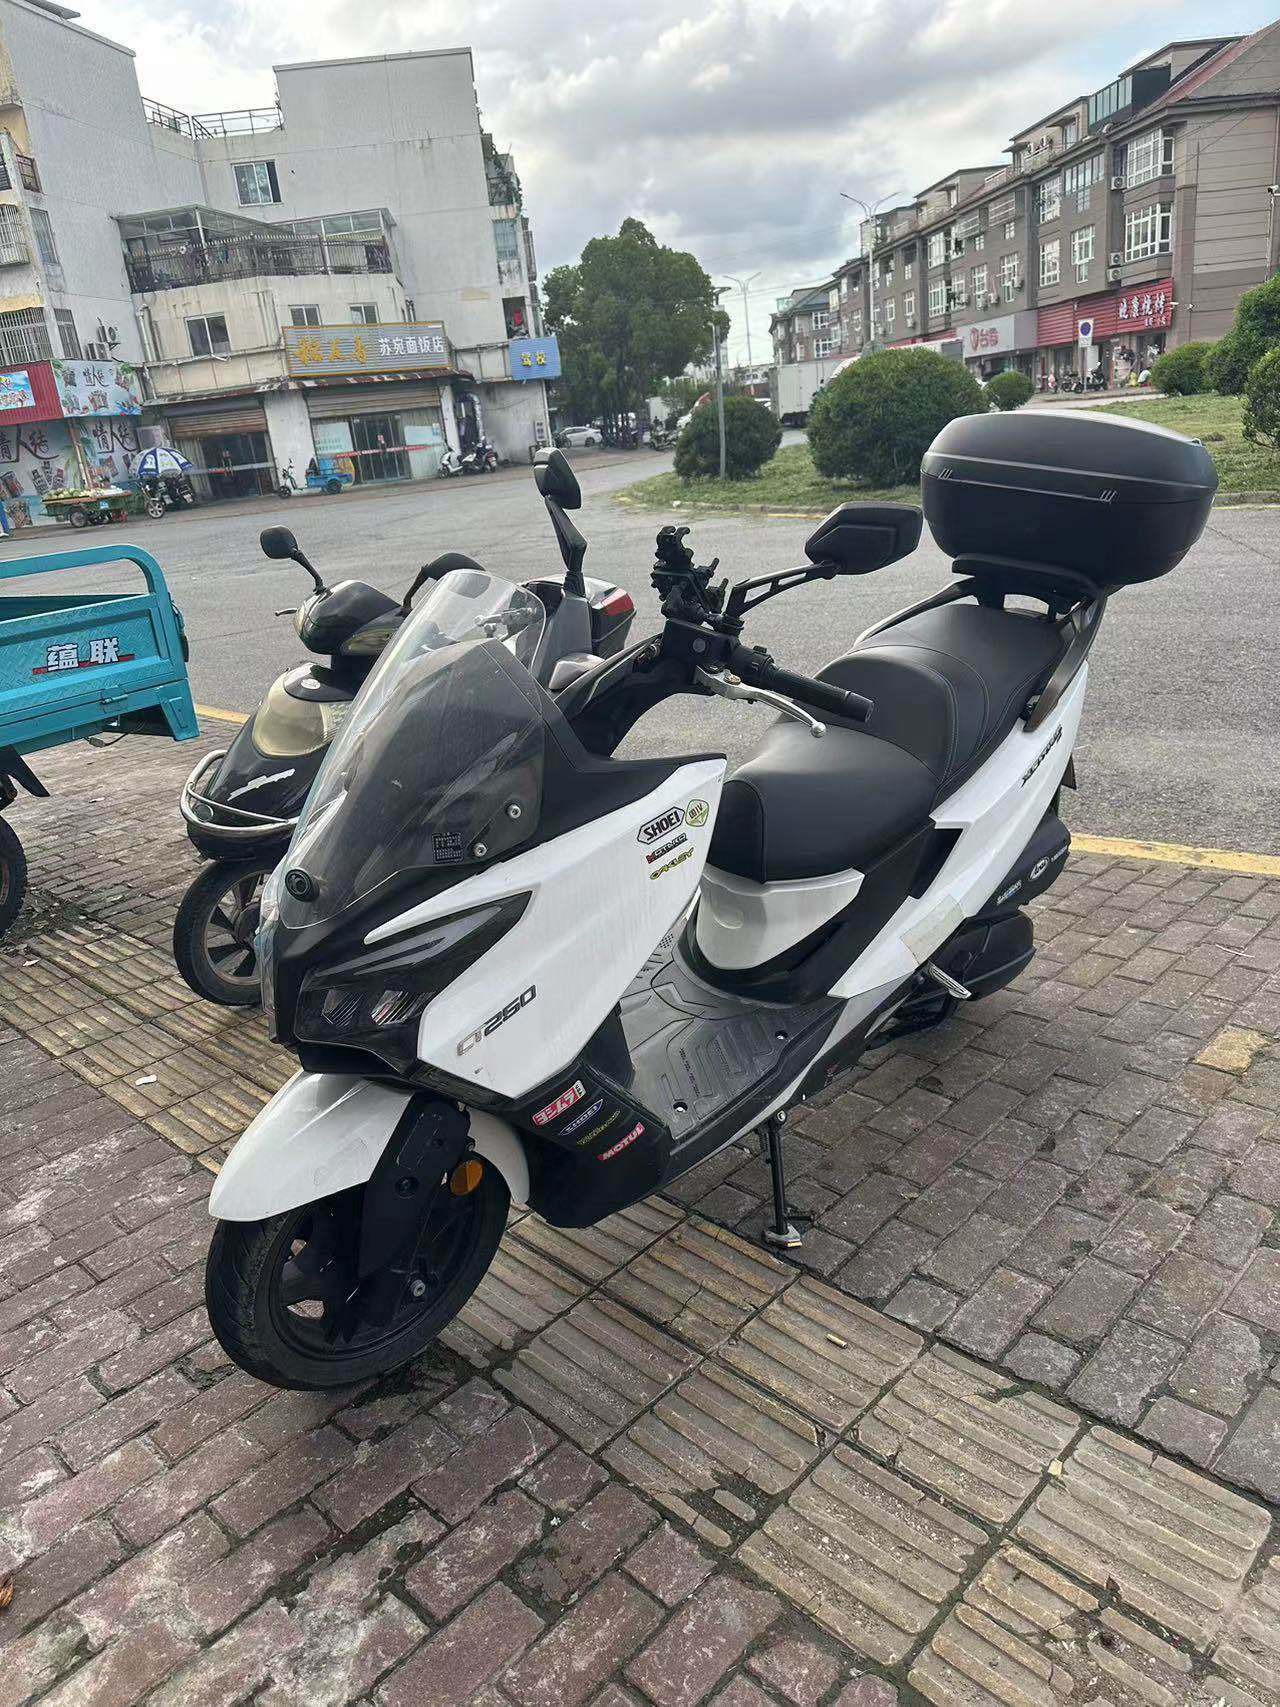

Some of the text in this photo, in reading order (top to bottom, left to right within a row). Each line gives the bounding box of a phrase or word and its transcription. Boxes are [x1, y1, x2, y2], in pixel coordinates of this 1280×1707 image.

[643, 810, 681, 841] SHOEI
[457, 985, 537, 1056] CT250
[602, 1122, 645, 1160] MOTUL
